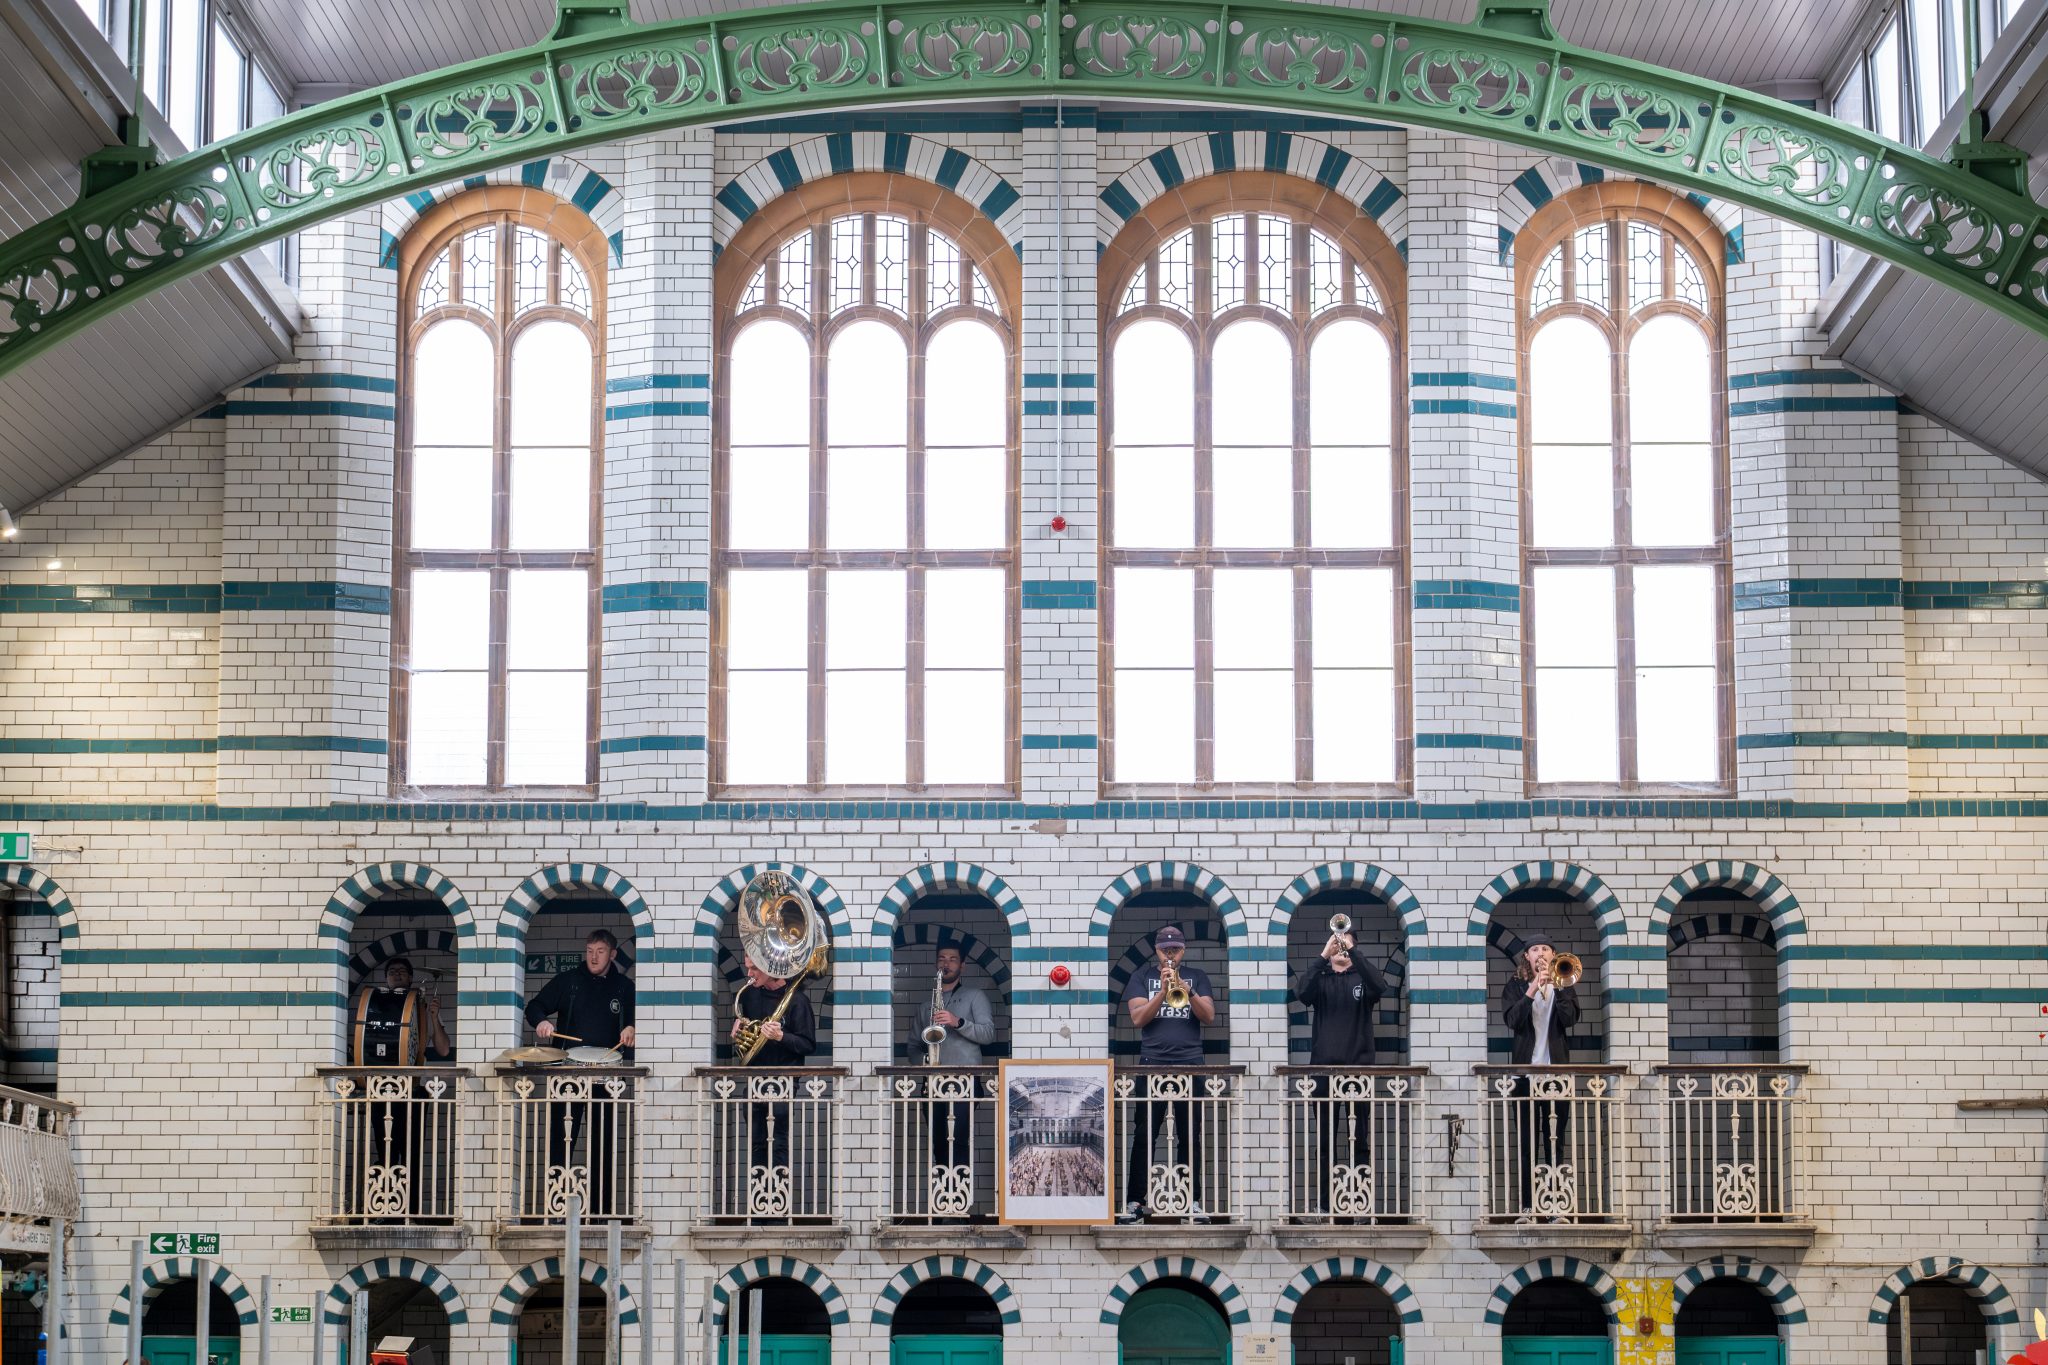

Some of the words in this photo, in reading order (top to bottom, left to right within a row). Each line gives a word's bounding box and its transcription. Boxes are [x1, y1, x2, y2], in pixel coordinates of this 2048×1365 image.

[768, 960, 788, 975] BAND
[1155, 1006, 1189, 1017] rass
[197, 1234, 217, 1243] Fire
[197, 1244, 215, 1253] exit
